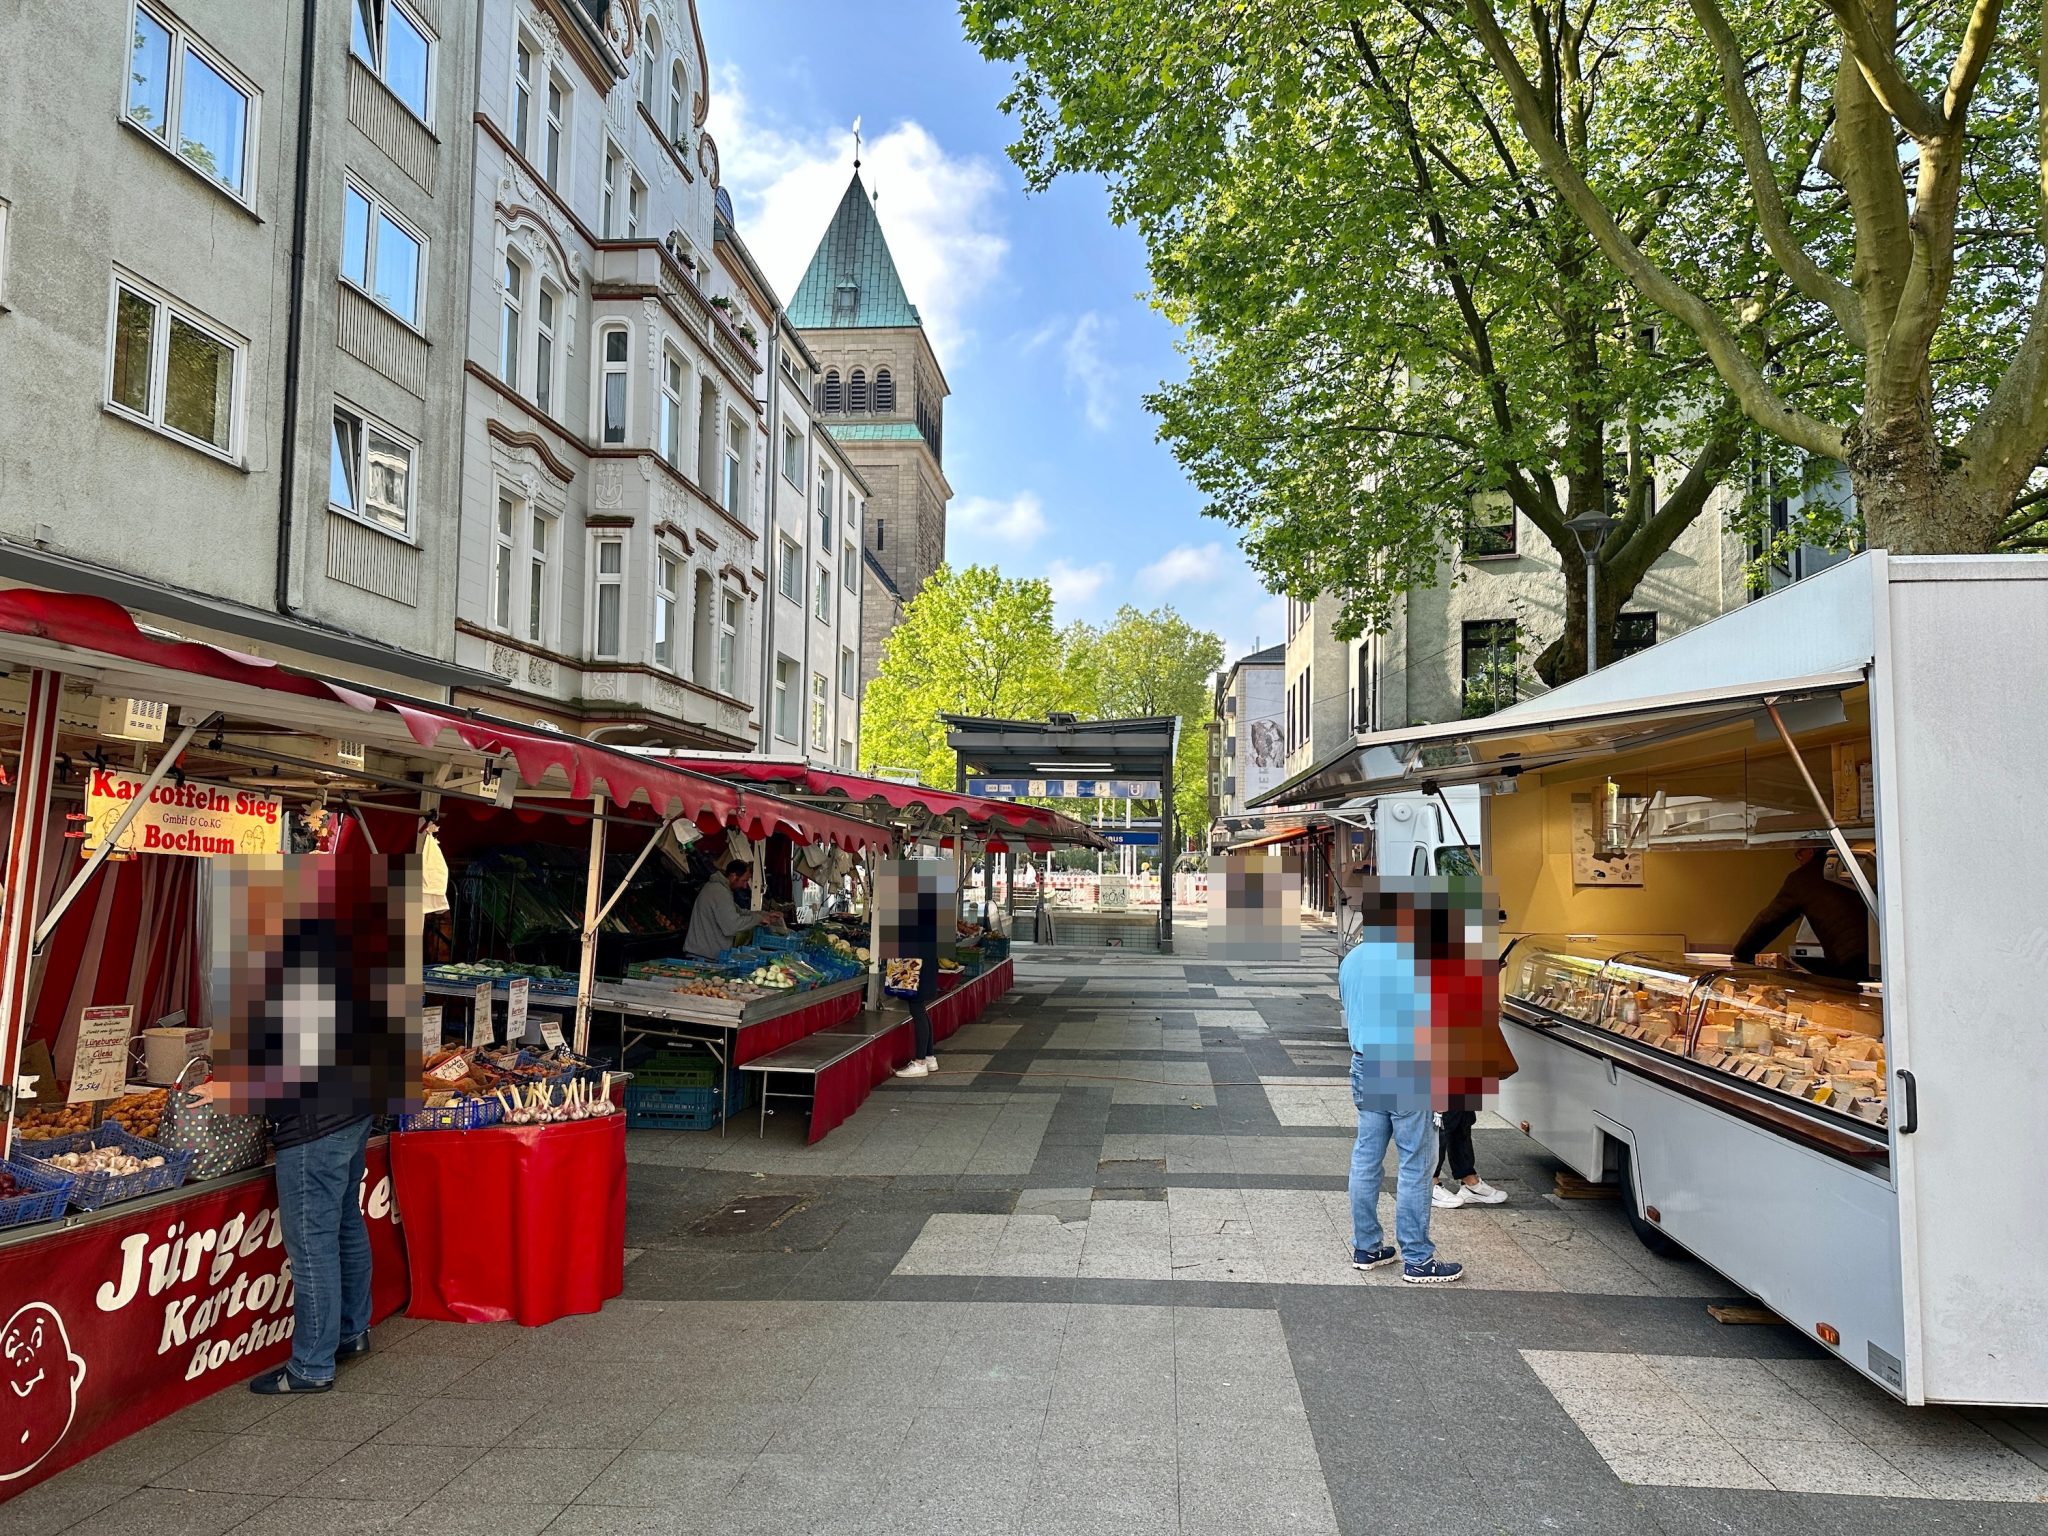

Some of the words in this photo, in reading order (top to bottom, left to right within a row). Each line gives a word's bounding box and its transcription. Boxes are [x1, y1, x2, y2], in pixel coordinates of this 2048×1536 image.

[162, 813, 188, 826] GmbH
[189, 815, 197, 826] &
[235, 791, 278, 824] Sieg
[144, 824, 235, 855] Bochum
[157, 1257, 294, 1356] Kartof
